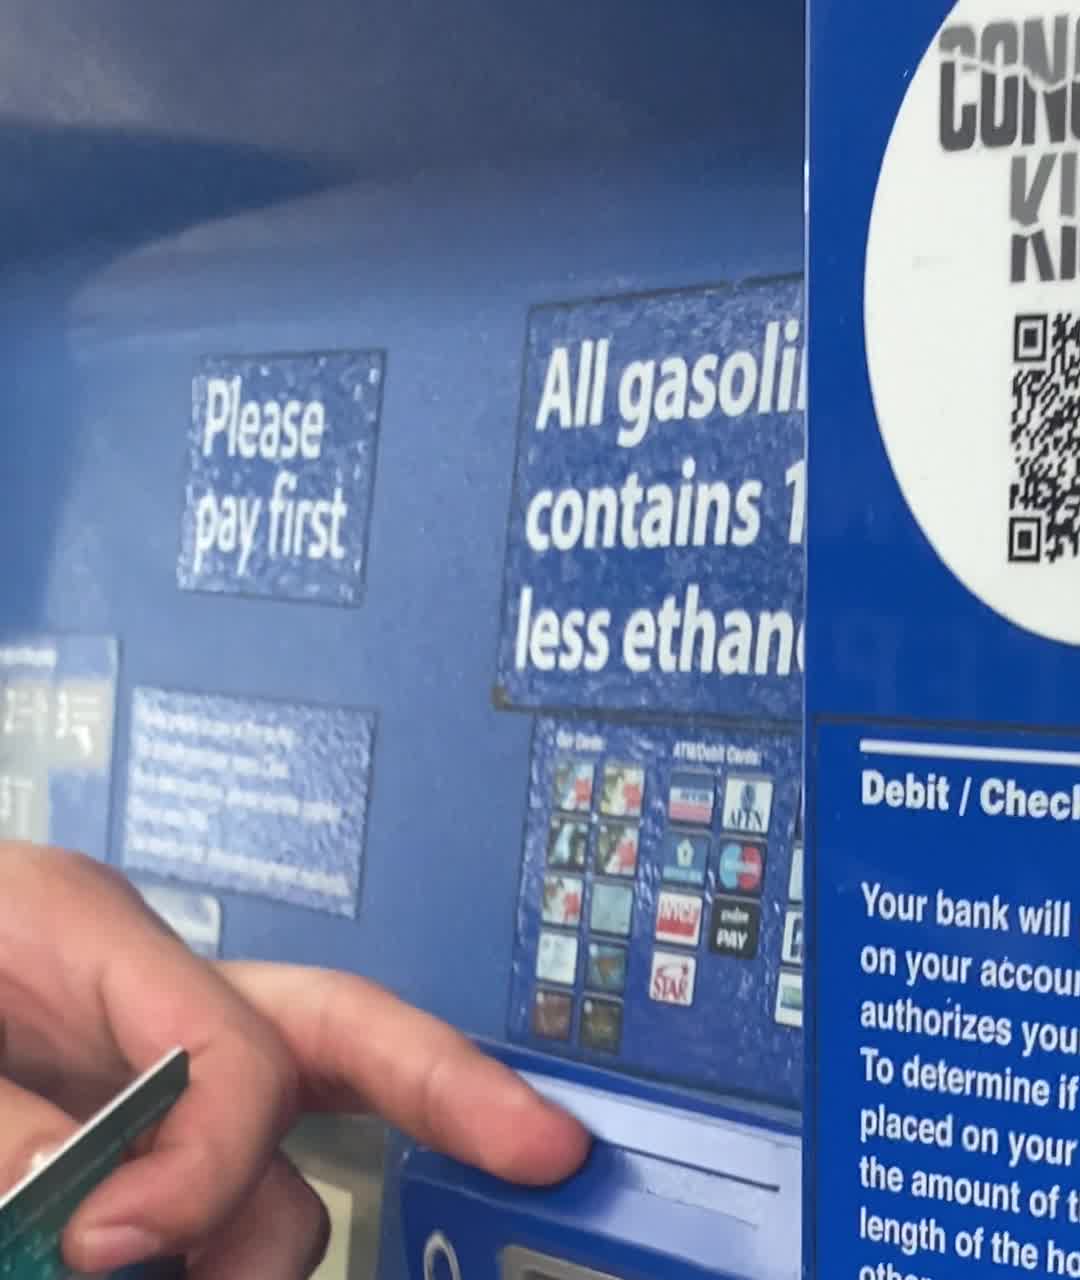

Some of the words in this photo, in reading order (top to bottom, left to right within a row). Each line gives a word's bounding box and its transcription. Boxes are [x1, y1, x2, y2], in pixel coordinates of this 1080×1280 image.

[535, 337, 611, 431] All
[616, 320, 806, 449] gasoli
[203, 377, 326, 461] Please
[193, 490, 262, 577] pay
[266, 471, 349, 561] first
[525, 455, 764, 552] contains
[515, 585, 612, 672] less
[622, 584, 805, 676] ethan
[861, 769, 950, 813] Debit
[958, 777, 971, 817] /
[861, 881, 928, 923] Your
[935, 888, 1009, 931] bank
[1018, 900, 1071, 938] will
[861, 944, 897, 976] on
[905, 951, 972, 986] your
[861, 997, 1012, 1046] authorizes
[861, 1047, 895, 1085] To
[902, 1053, 1050, 1108] determine
[1058, 1074, 1079, 1113] if
[861, 1105, 953, 1148] placed
[961, 1124, 998, 1155] on
[1007, 1130, 1078, 1168] your
[859, 1156, 904, 1193] the
[911, 1166, 1021, 1215] amount
[1028, 1184, 1060, 1220] of
[860, 1207, 947, 1258] length
[954, 1228, 984, 1261] of
[991, 1232, 1039, 1271] the
